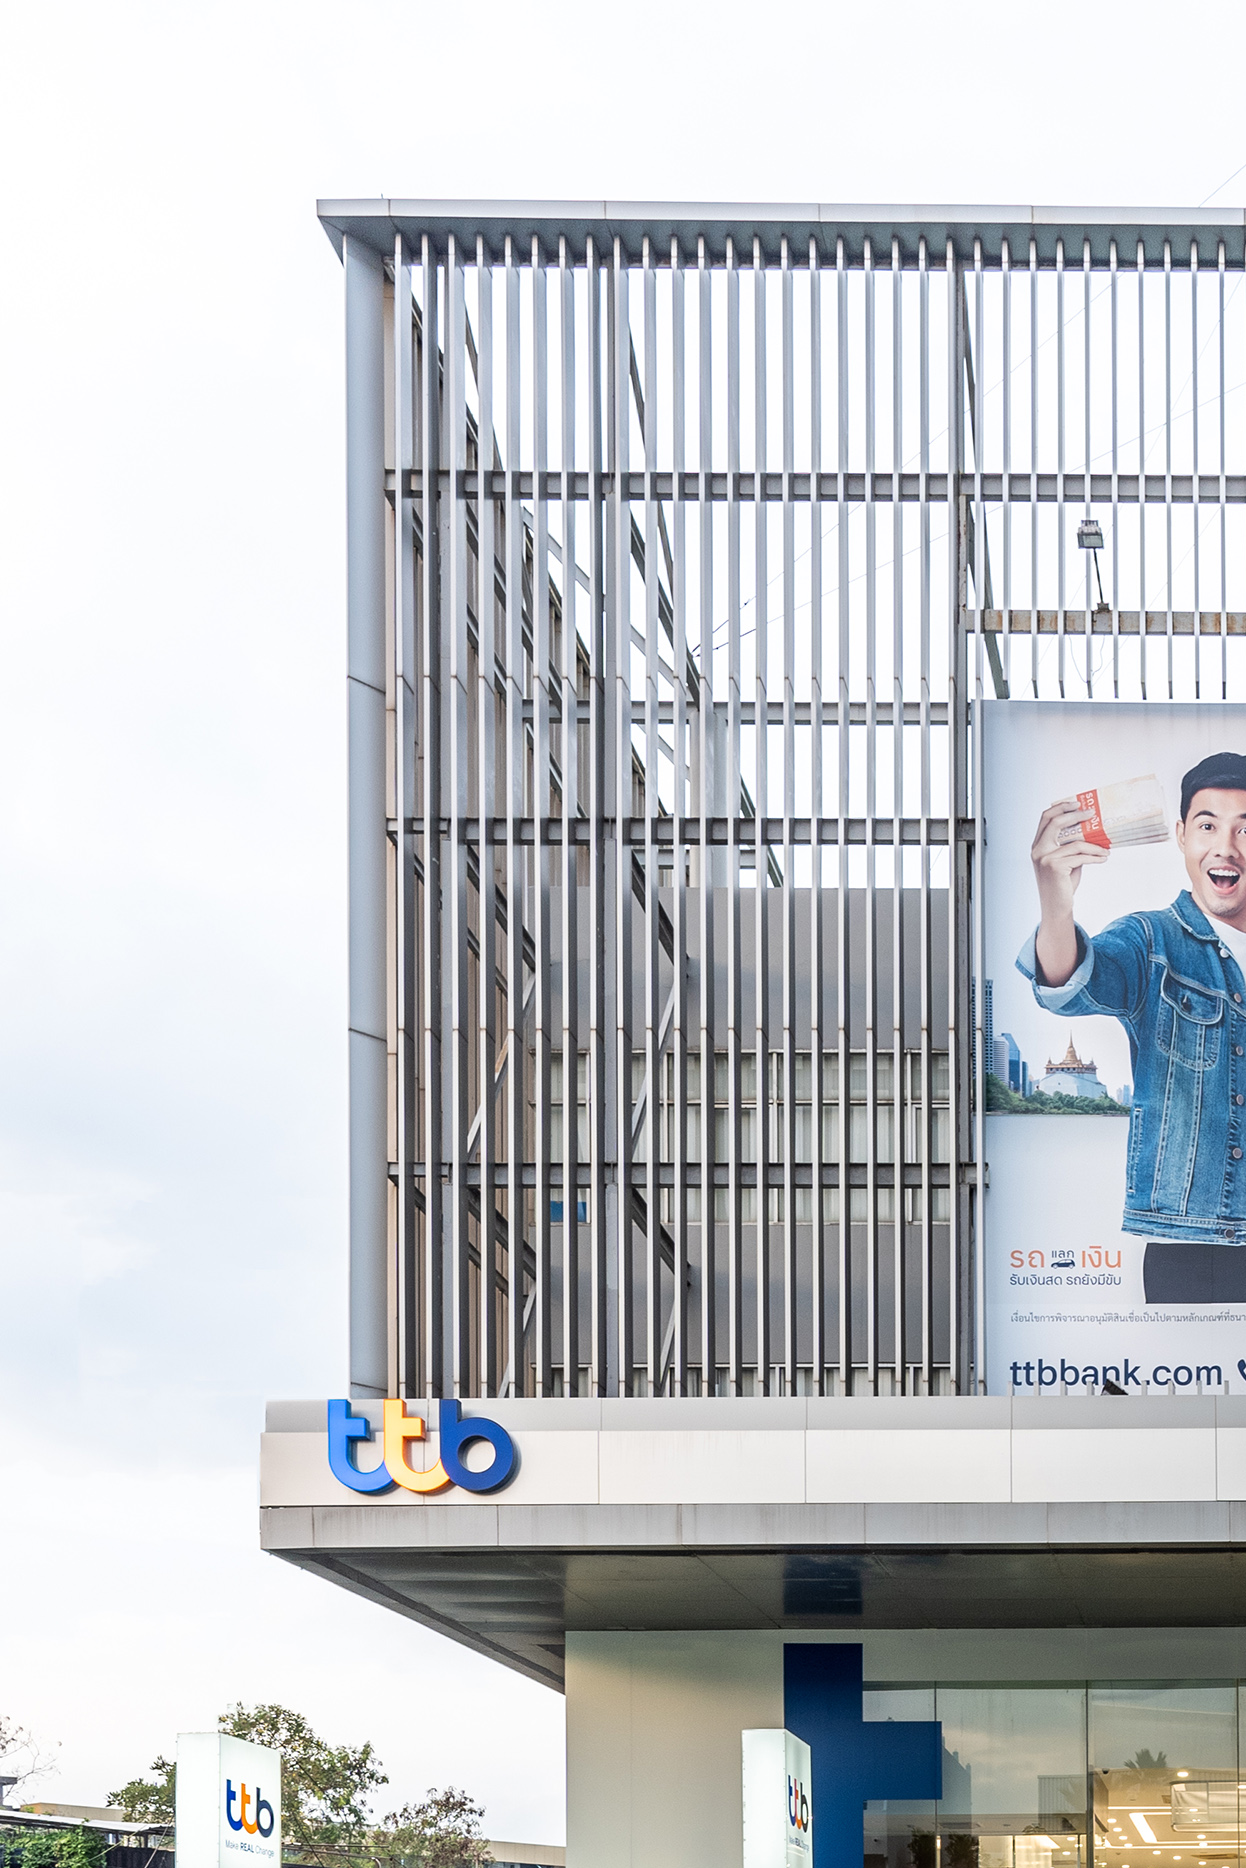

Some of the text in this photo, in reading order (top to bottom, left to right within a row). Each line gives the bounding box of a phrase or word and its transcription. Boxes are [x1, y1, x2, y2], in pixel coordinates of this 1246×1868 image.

[1010, 1246, 1121, 1269] รถ แลก เงิน
[1009, 1274, 1121, 1286] รับเงินสด รถยังมีขับ
[1009, 1358, 1223, 1386] ttbbank.com
[328, 1399, 514, 1493] ttb
[226, 1779, 274, 1838] ttb
[788, 1775, 808, 1833] ttb
[240, 1842, 254, 1853] REAL
